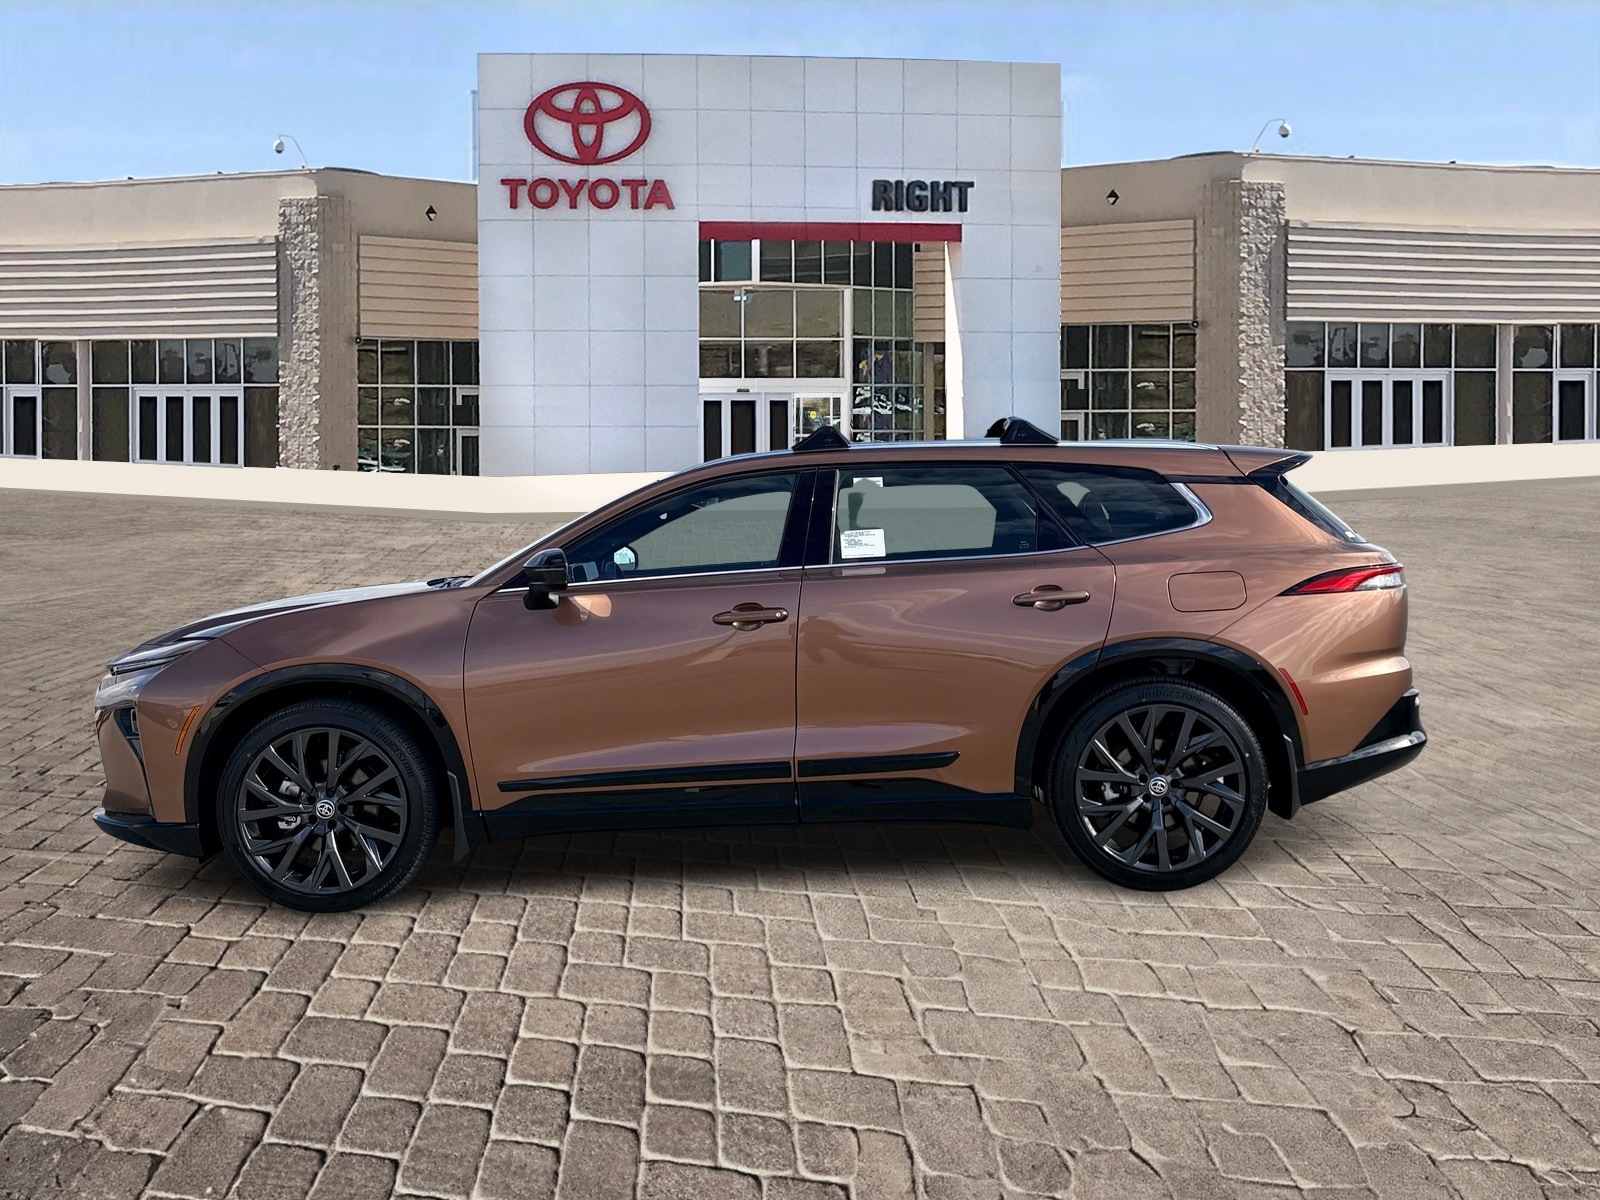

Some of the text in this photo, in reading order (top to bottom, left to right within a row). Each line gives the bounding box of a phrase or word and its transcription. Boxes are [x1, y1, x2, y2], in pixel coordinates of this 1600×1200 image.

[500, 178, 675, 209] TOYOTA
[872, 179, 974, 212] RIGHT
[370, 726, 416, 780] BRIDGESTONE
